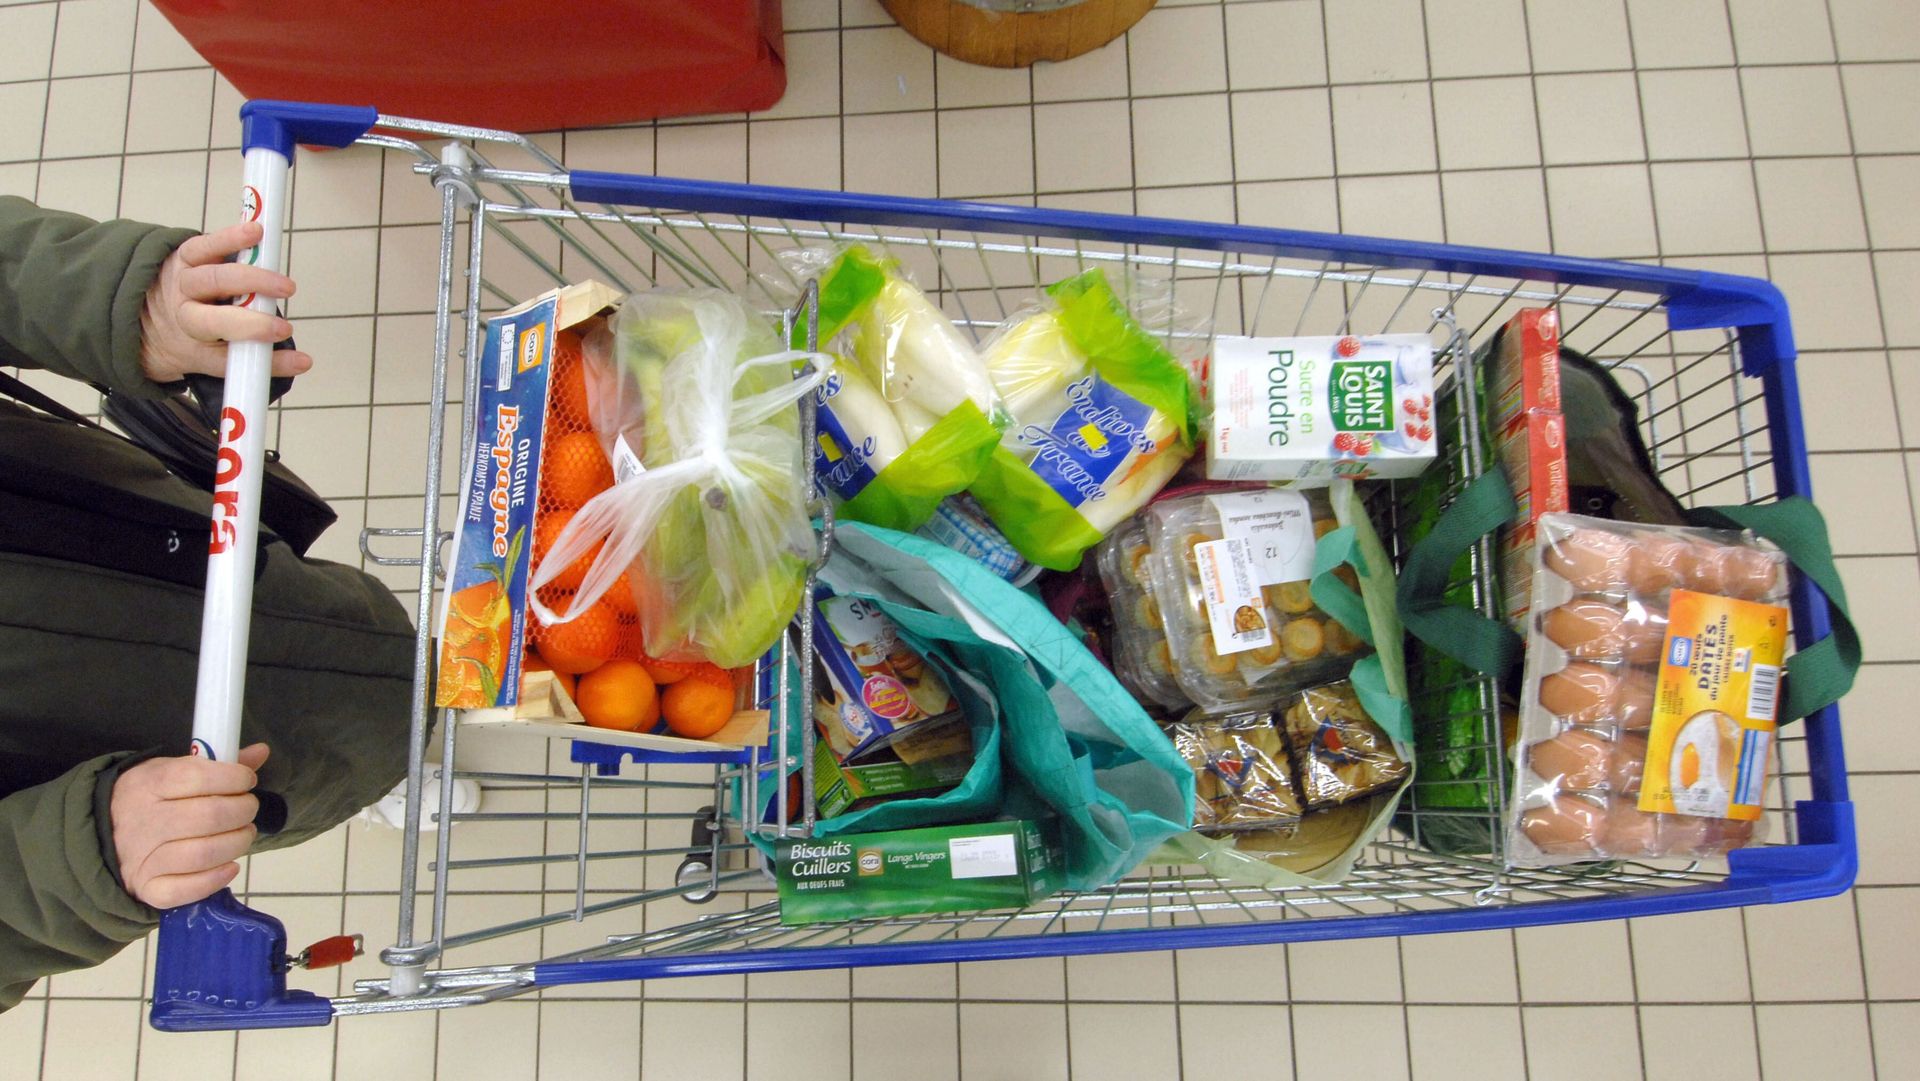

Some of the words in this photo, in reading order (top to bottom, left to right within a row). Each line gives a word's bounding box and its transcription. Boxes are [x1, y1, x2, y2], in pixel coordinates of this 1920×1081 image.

[527, 332, 537, 363] cora
[1268, 349, 1295, 447] Poudre
[1299, 359, 1316, 407] Sucre
[1339, 366, 1364, 427] LOUIS
[1364, 365, 1387, 428] SAINT
[1064, 375, 1157, 455] Endives
[1299, 412, 1313, 434] en
[474, 442, 491, 489] HERKOMST
[511, 438, 531, 508] ORIGINE
[1017, 424, 1106, 502] France
[208, 406, 247, 555] cora
[489, 403, 520, 558] Espagne
[468, 489, 485, 522] SPANJE
[1265, 547, 1277, 559] 12
[1719, 614, 1728, 645] ponte
[1717, 646, 1723, 661] de
[1713, 664, 1722, 685] jour
[1709, 687, 1718, 701] du
[790, 840, 851, 860] Biscuits
[861, 857, 880, 866] cora
[888, 852, 913, 865] Lange
[915, 850, 946, 863] Vingers
[792, 860, 851, 877] Cuillers
